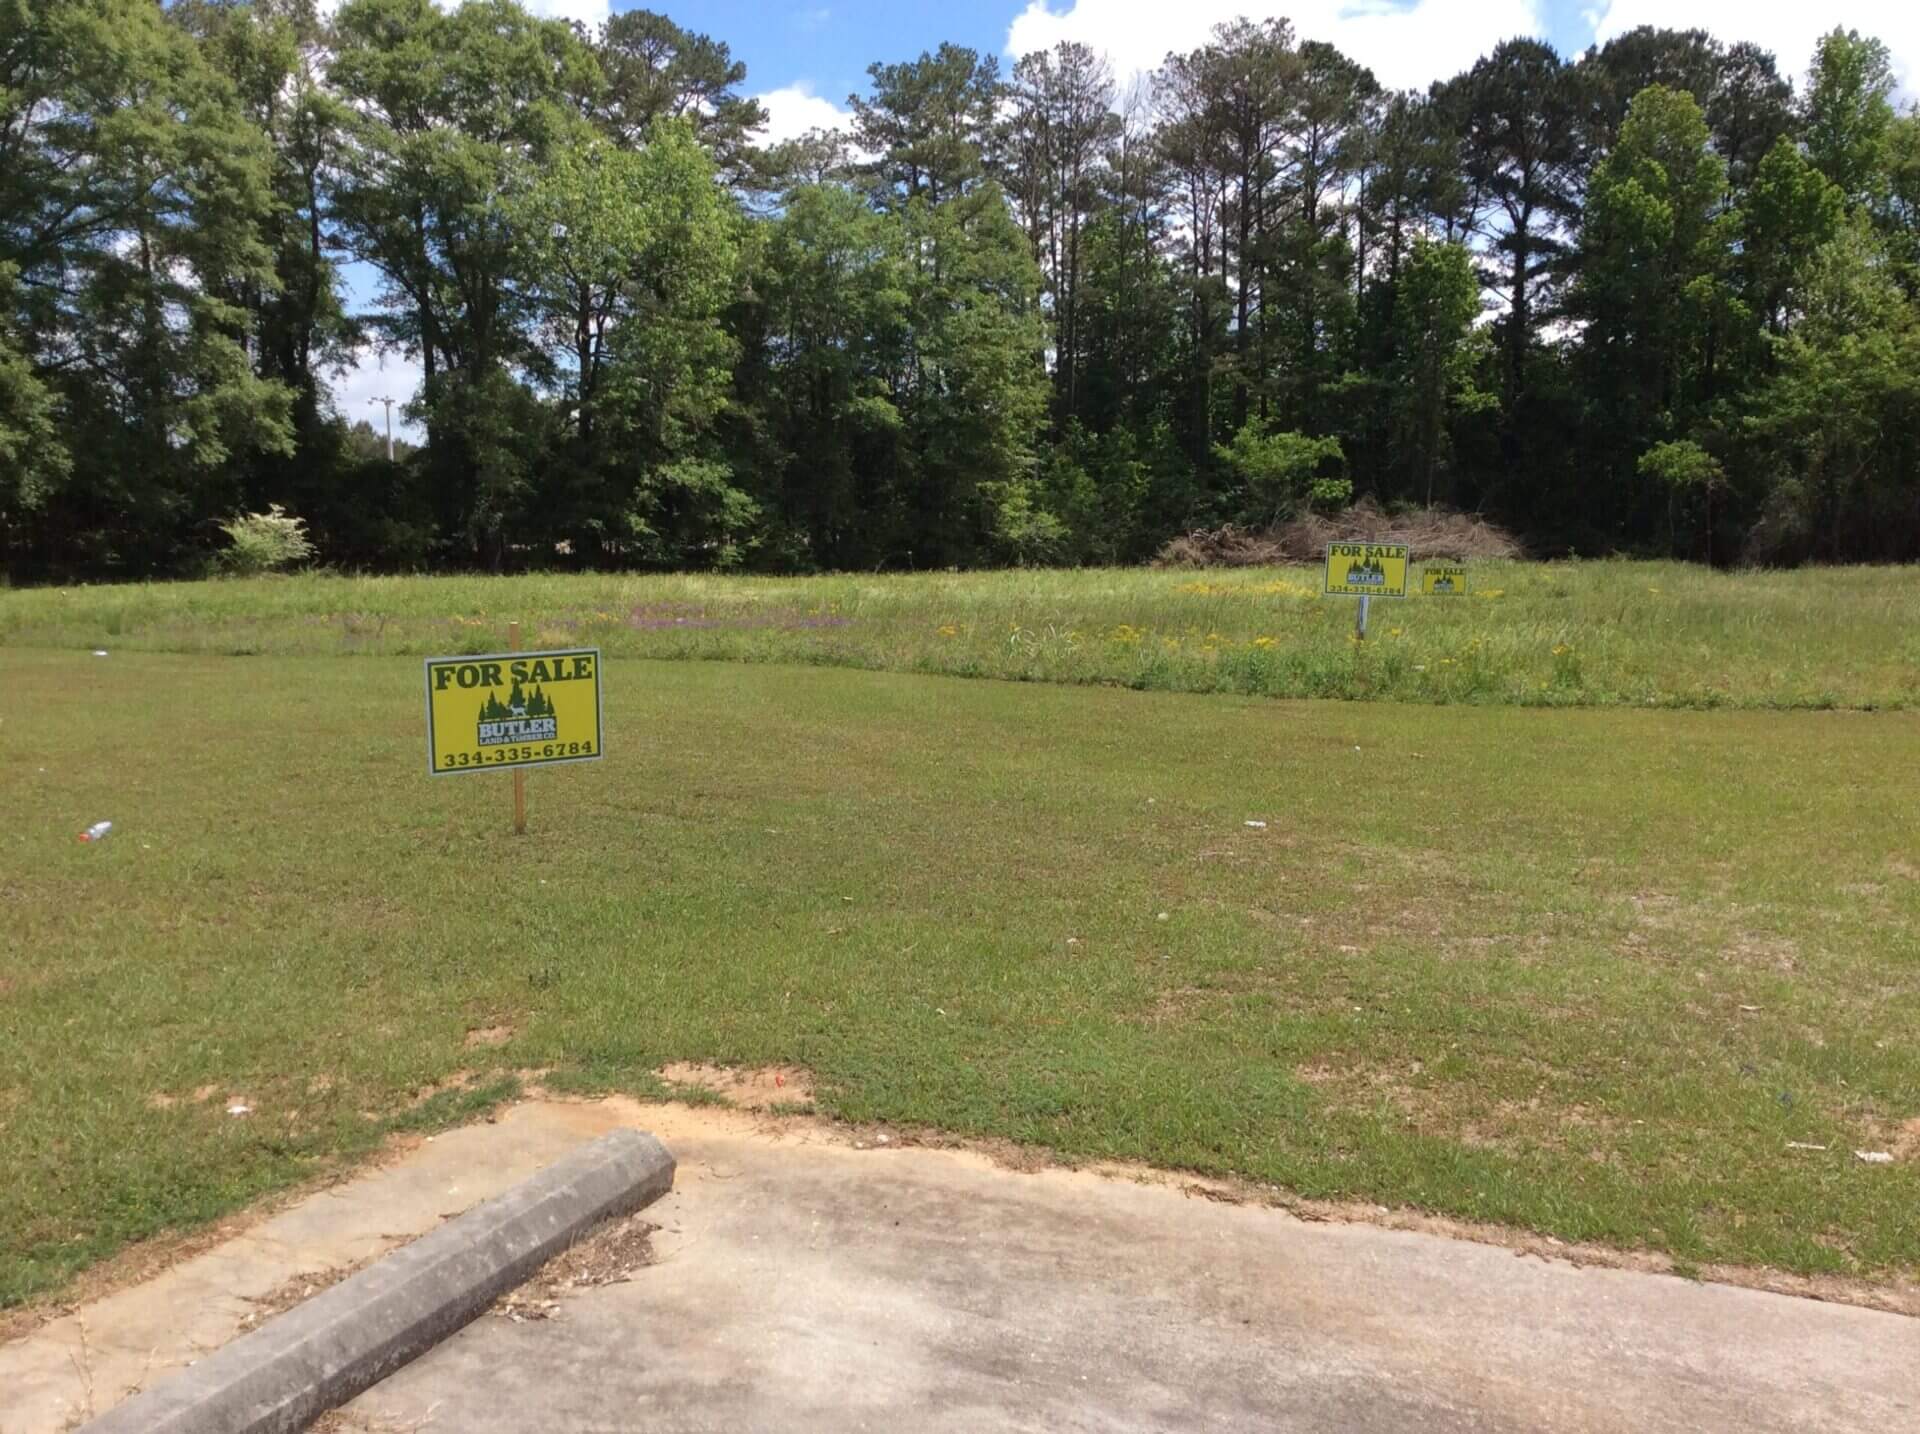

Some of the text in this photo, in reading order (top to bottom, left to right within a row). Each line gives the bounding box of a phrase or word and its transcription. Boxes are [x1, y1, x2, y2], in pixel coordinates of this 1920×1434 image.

[1331, 545, 1405, 558] FOR SALE
[1425, 568, 1465, 576] FOR SALE
[435, 657, 592, 690] FOR SALE
[479, 718, 555, 738] BUTLER
[480, 737, 502, 745] LAND
[444, 741, 592, 767] 334-335-6784
